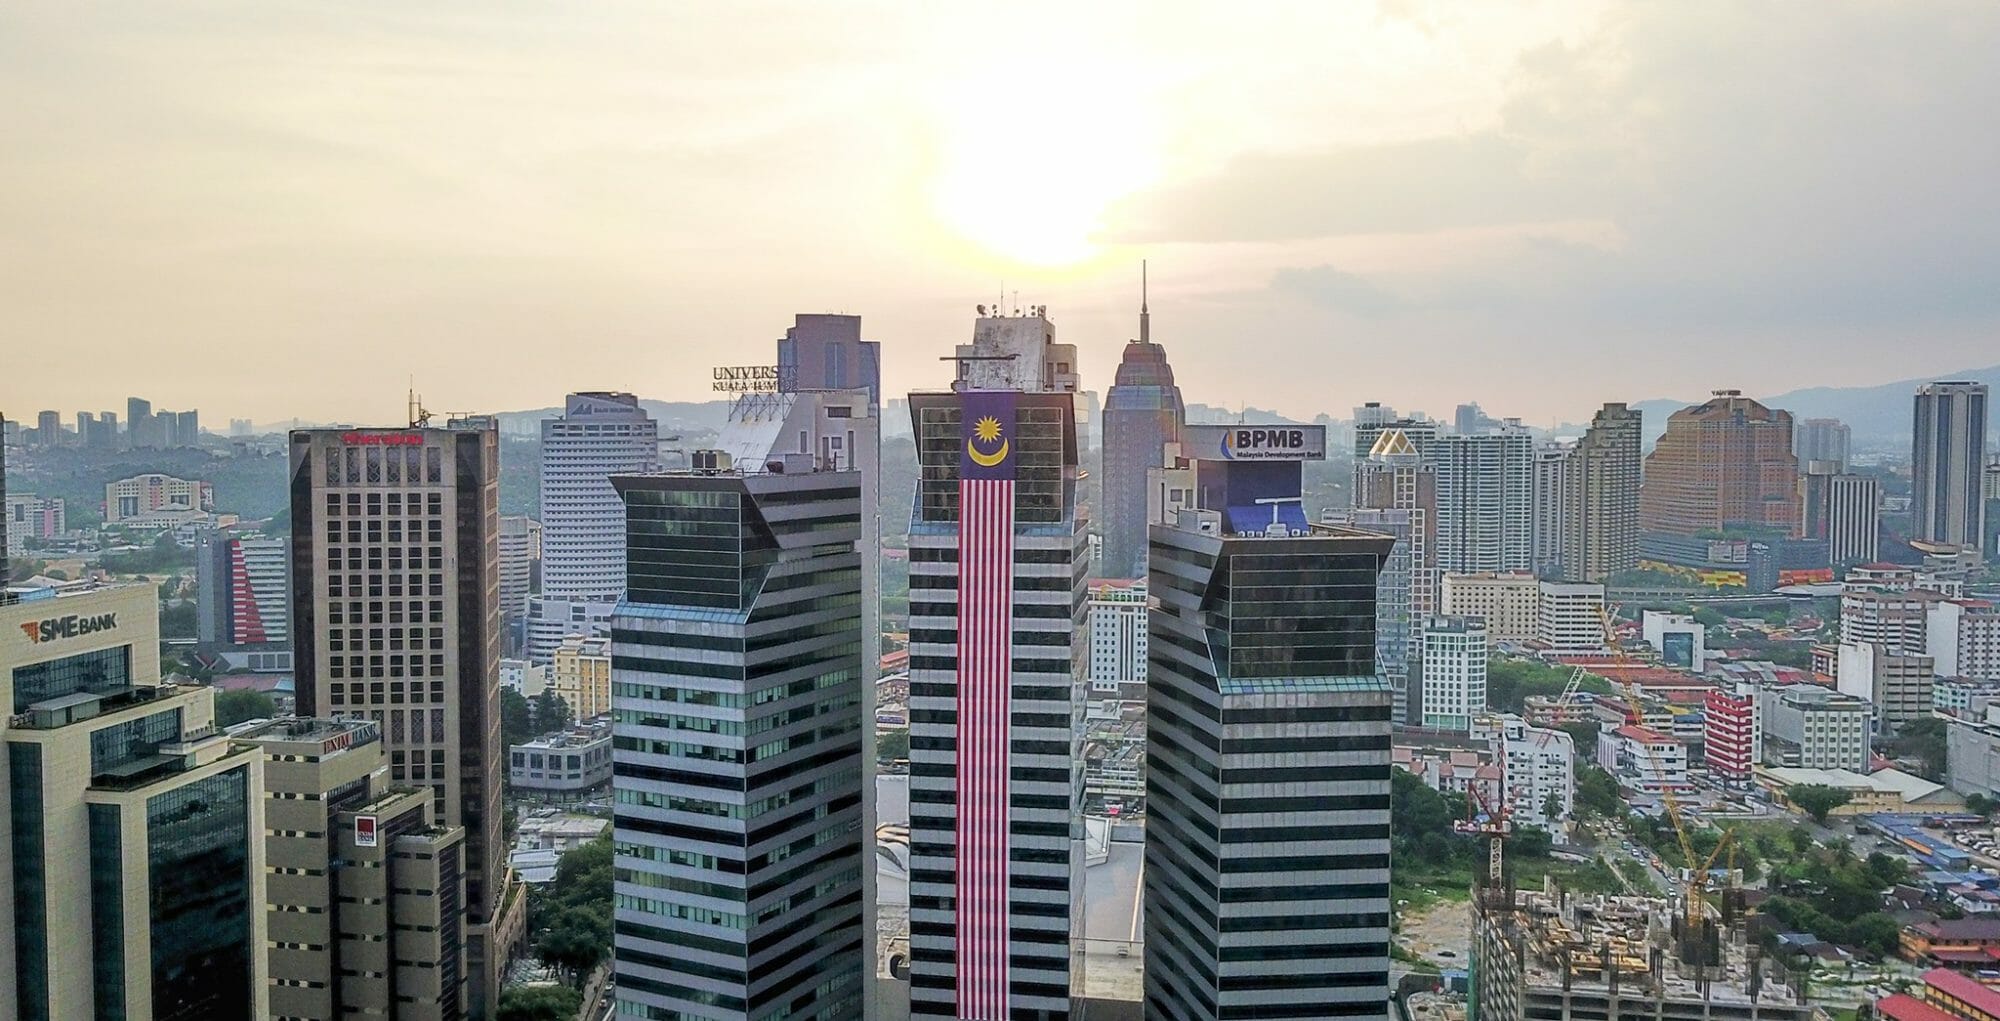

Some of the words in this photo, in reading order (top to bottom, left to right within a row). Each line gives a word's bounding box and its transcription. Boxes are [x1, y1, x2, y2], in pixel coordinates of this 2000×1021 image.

[713, 381, 748, 391] KUALA
[1237, 430, 1303, 448] BPMB
[1237, 451, 1263, 459] Malaysia
[1264, 451, 1305, 459] Development
[40, 615, 78, 642] SME
[80, 613, 117, 635] BANK
[324, 732, 352, 755] EXIM
[352, 723, 377, 744] BANK
